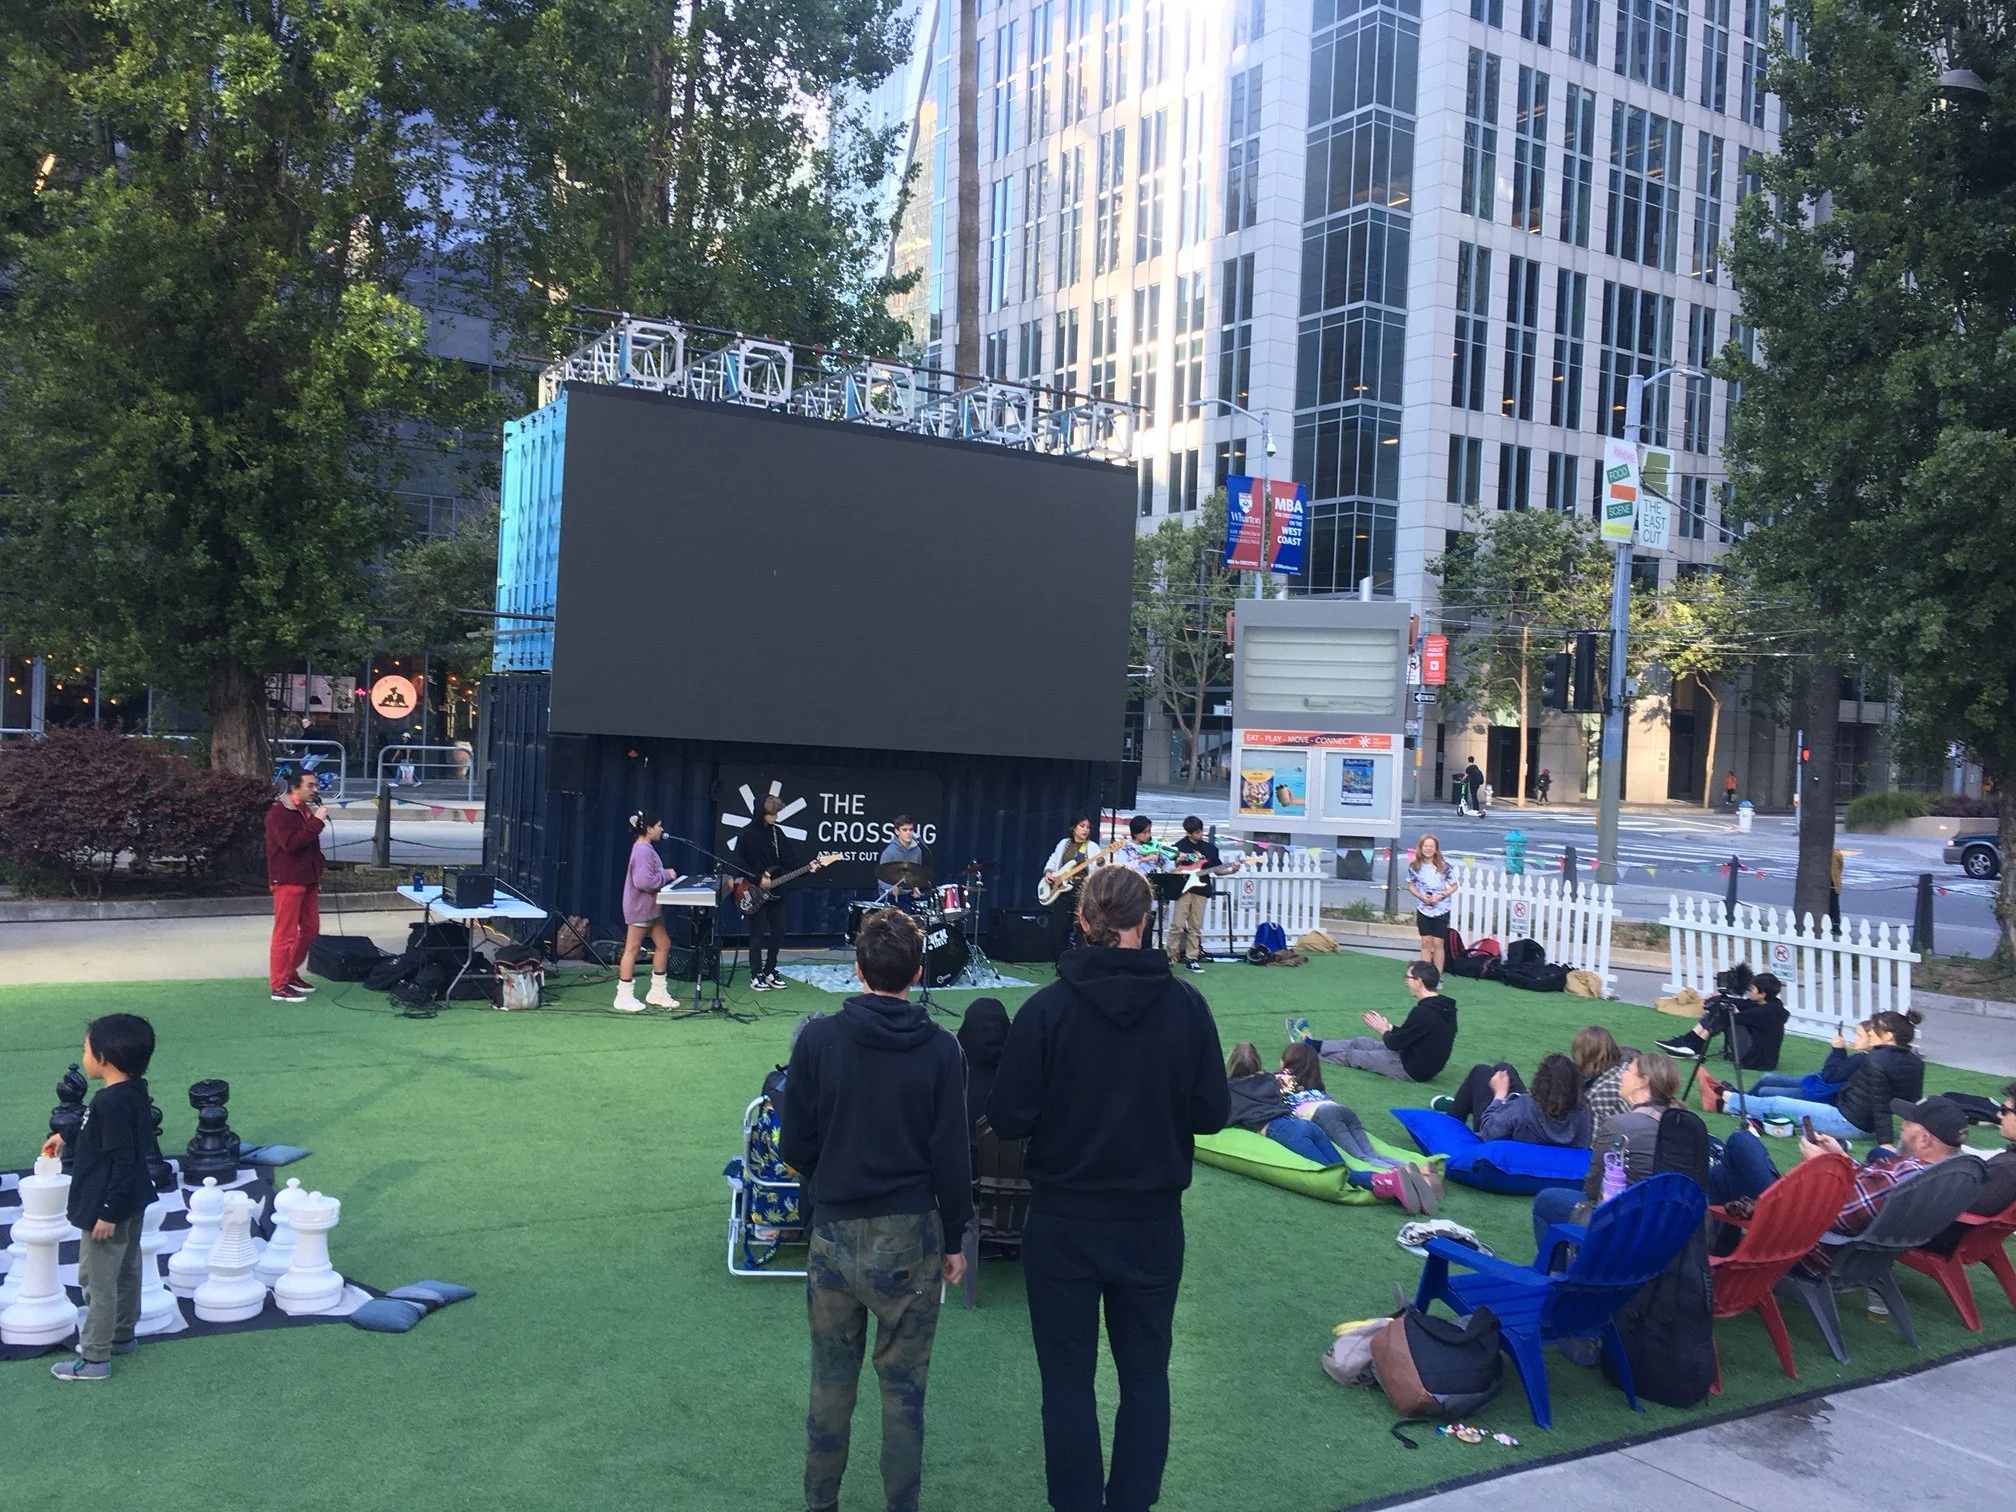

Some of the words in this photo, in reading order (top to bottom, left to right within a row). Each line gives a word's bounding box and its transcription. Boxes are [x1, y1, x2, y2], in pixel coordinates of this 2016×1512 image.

[1609, 467, 1628, 480] FOOD
[1274, 497, 1304, 514] MBA
[1608, 505, 1631, 517] SCENE
[1643, 499, 1662, 515] THE
[1230, 511, 1262, 525] Wharton
[1643, 514, 1667, 531] EAST
[1281, 526, 1303, 537] WEST
[1642, 529, 1661, 545] CUT
[1277, 535, 1302, 547] COAST
[1246, 733, 1259, 742] EAT
[1264, 734, 1282, 743] PLAY
[1287, 735, 1310, 744] MOVE
[1315, 737, 1354, 746] CONNECT
[819, 793, 866, 815] THE
[818, 821, 937, 845] CROSSG
[858, 851, 880, 862] CUT
